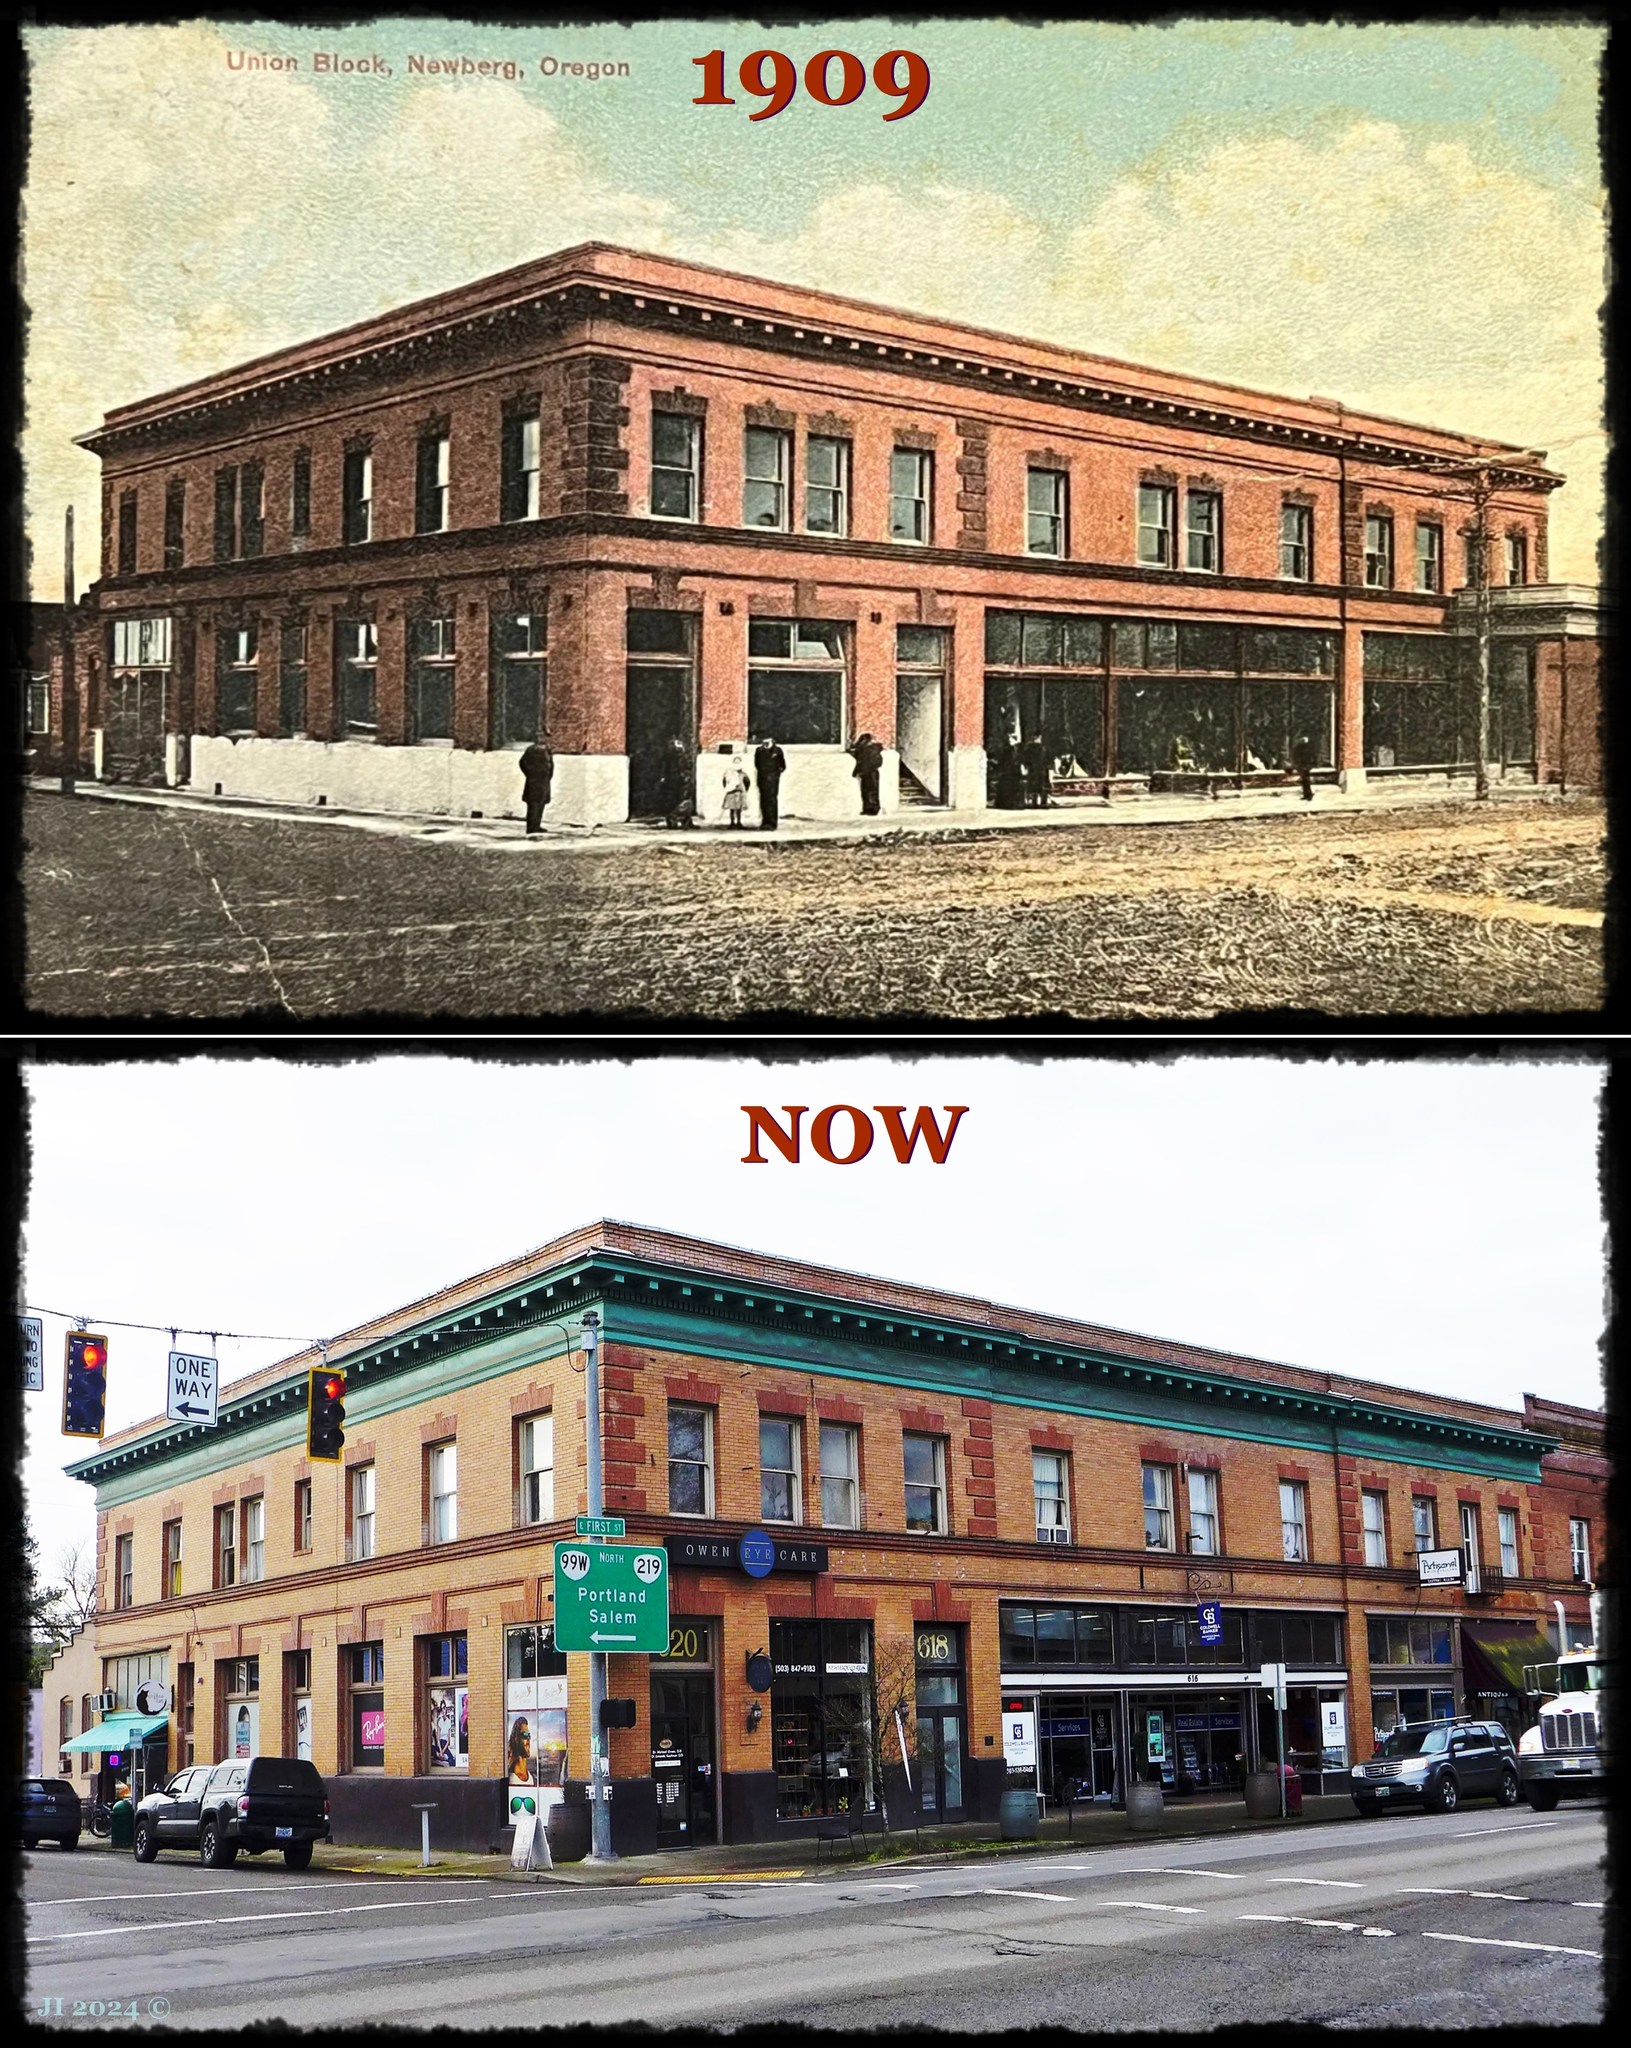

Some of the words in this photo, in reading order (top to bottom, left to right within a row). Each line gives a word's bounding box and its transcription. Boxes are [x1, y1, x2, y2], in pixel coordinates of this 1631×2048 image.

[176, 1357, 211, 1378] ONE
[175, 1377, 213, 1399] WAY
[579, 1522, 584, 1530] E
[586, 1521, 611, 1533] FIRST
[614, 1524, 621, 1532] ST
[686, 1544, 730, 1557] OWEN
[744, 1547, 771, 1560] EYE
[779, 1550, 817, 1563] CARE
[561, 1553, 588, 1571] 99W
[637, 1558, 661, 1575] 219
[578, 1587, 646, 1603] Portland
[589, 1608, 637, 1624] Salem
[659, 1629, 698, 1657] 20
[917, 1634, 949, 1659] 618
[775, 1664, 790, 1674] (503)
[1187, 1674, 1199, 1683] 616
[1058, 1723, 1081, 1732] Services
[1177, 1718, 1187, 1727] Real
[1188, 1718, 1204, 1727] Estate
[1214, 1716, 1234, 1726] Services
